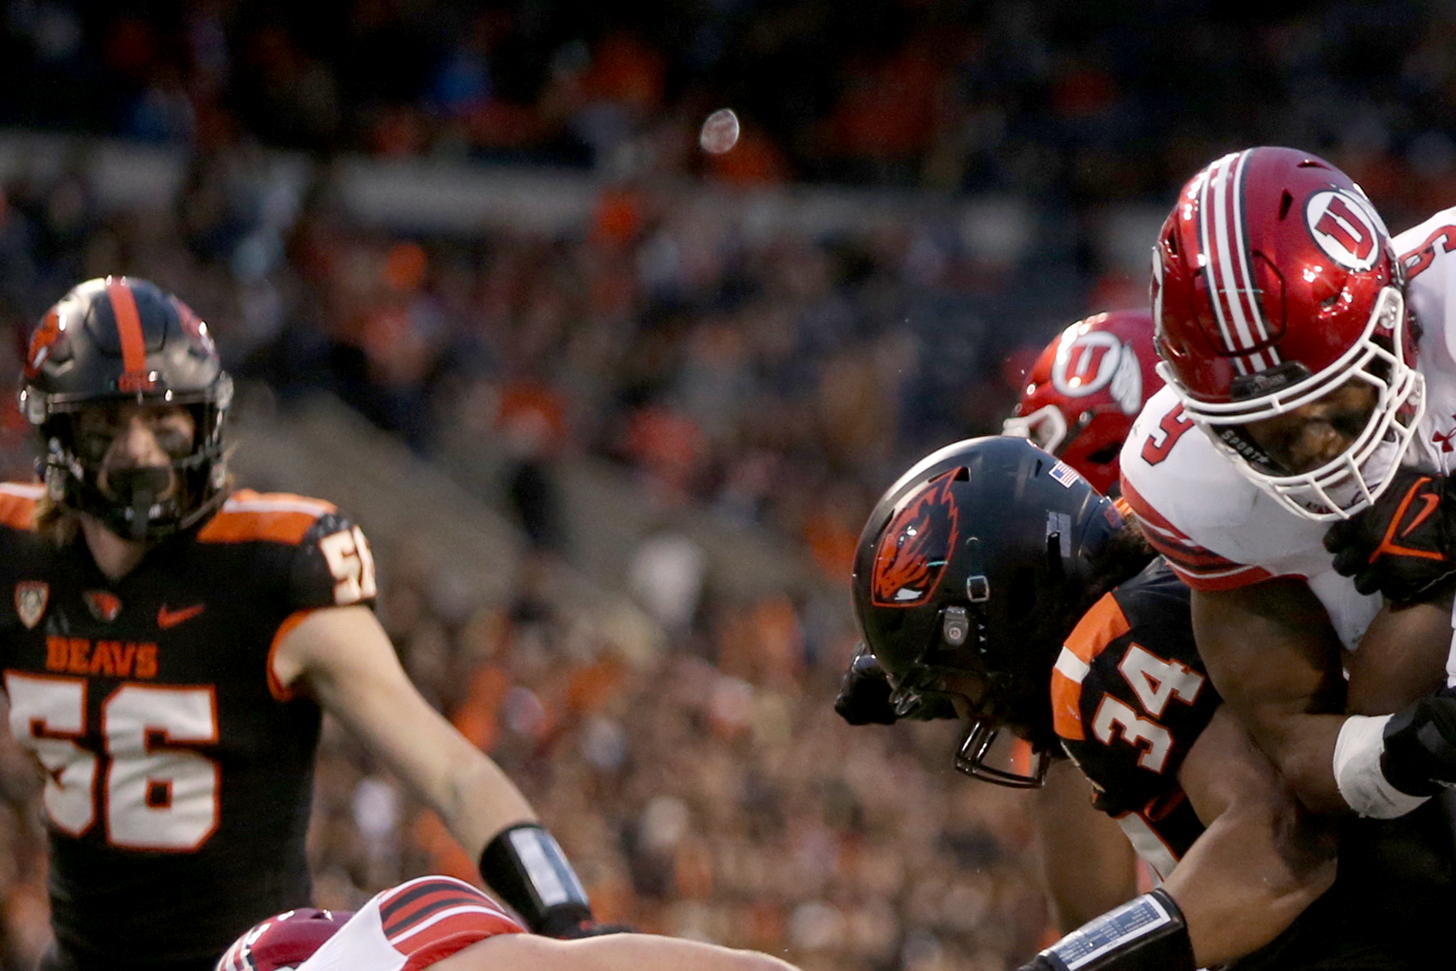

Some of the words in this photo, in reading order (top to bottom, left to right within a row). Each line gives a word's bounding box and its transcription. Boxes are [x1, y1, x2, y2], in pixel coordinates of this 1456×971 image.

[1313, 194, 1375, 261] U
[1064, 345, 1112, 388] U
[46, 636, 158, 679] BEAVS
[1091, 642, 1206, 776] 34
[3, 668, 222, 854] 56
